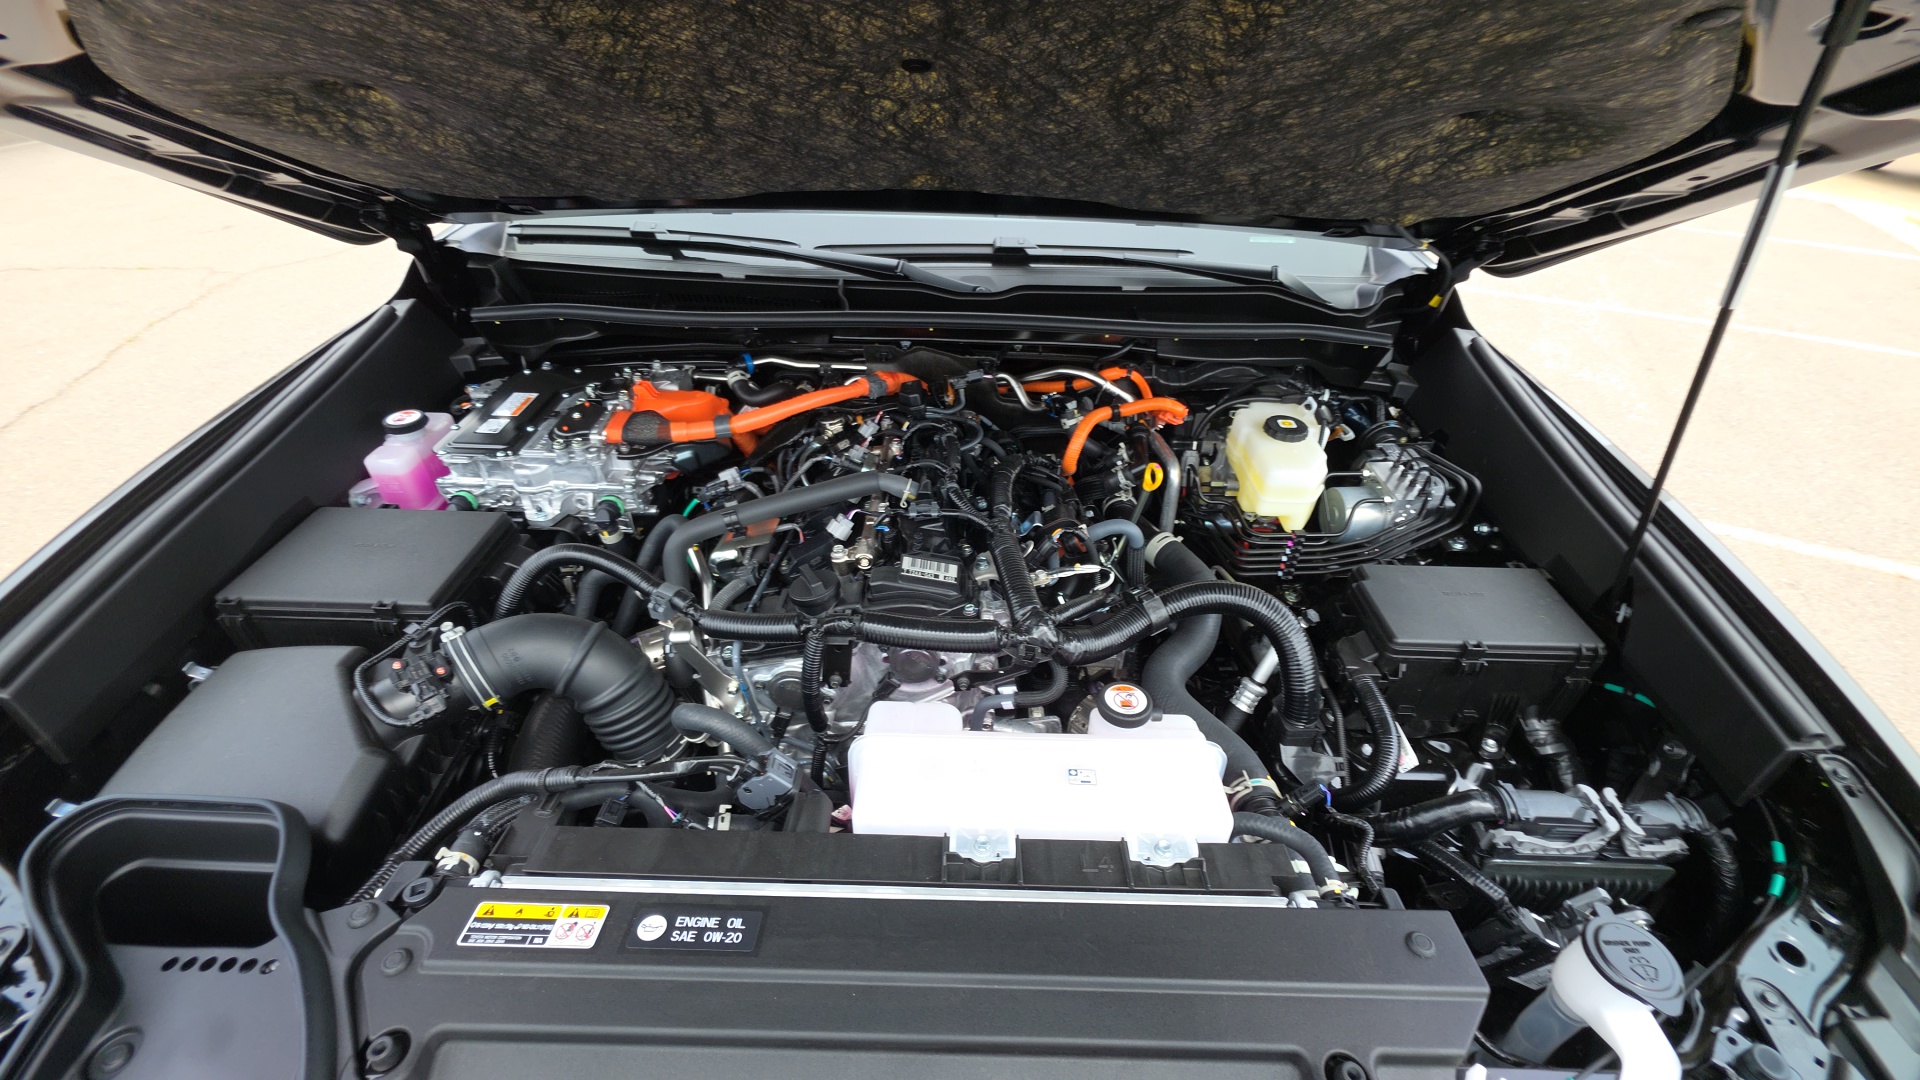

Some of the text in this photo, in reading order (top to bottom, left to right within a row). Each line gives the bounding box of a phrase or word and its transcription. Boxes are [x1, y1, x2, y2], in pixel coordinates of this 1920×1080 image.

[675, 916, 746, 928] ENGINE OIL
[670, 930, 743, 944] SAE 0W-20
